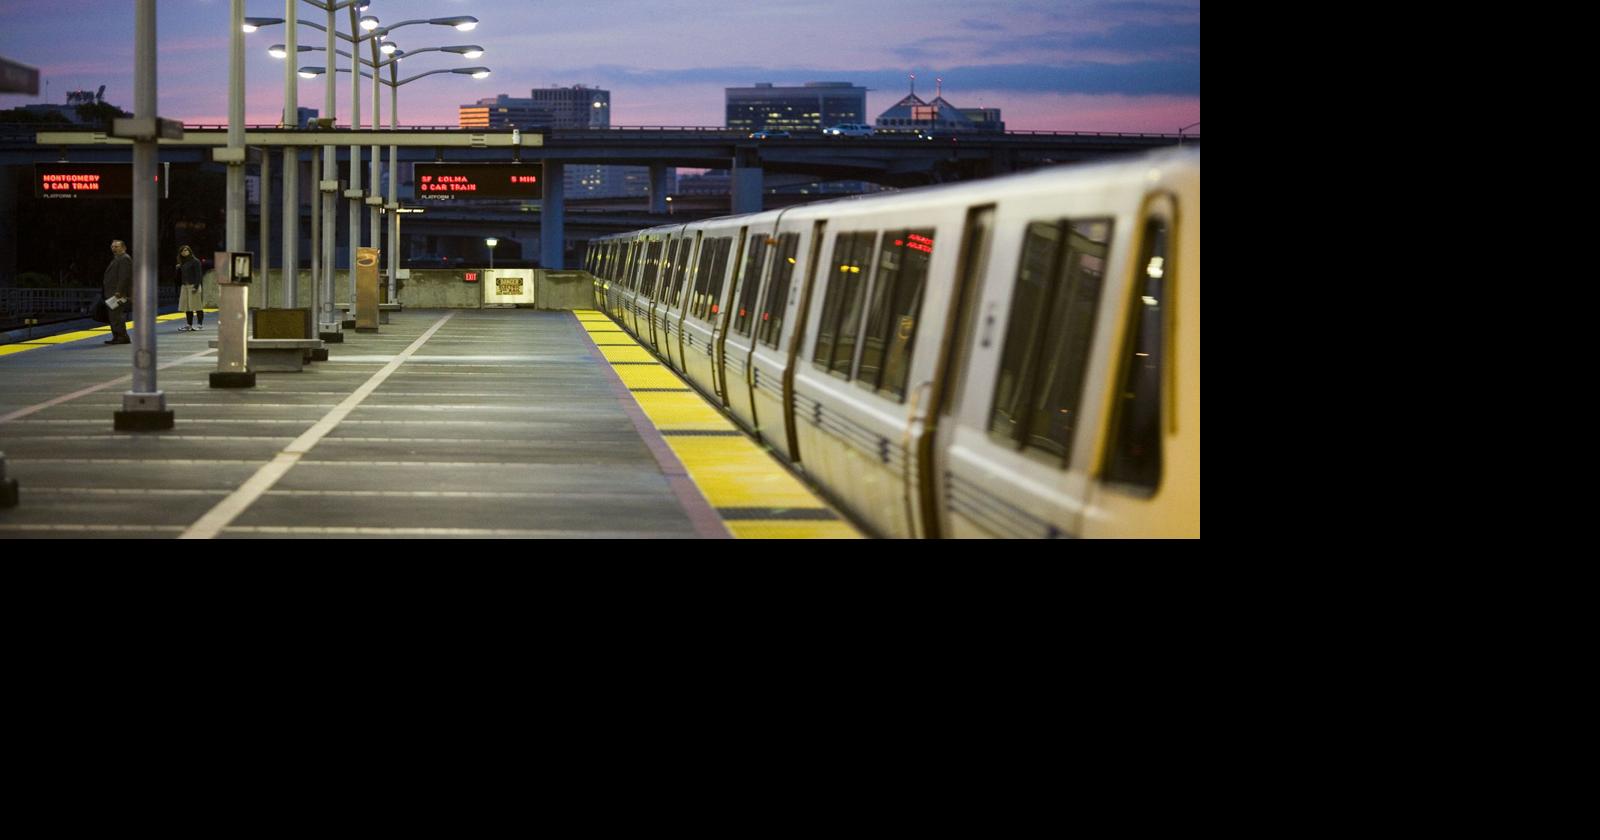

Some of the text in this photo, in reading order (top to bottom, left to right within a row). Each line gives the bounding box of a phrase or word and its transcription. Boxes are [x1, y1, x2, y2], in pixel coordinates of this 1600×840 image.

[43, 174, 100, 182] MONTGOMERY
[421, 175, 468, 183] SF COLMA
[519, 175, 536, 183] MIN
[51, 182, 70, 190] CAR
[72, 182, 99, 190] TRAIN
[430, 183, 447, 191] CAR
[450, 183, 477, 191] TRAIN
[465, 272, 477, 281] EXIT
